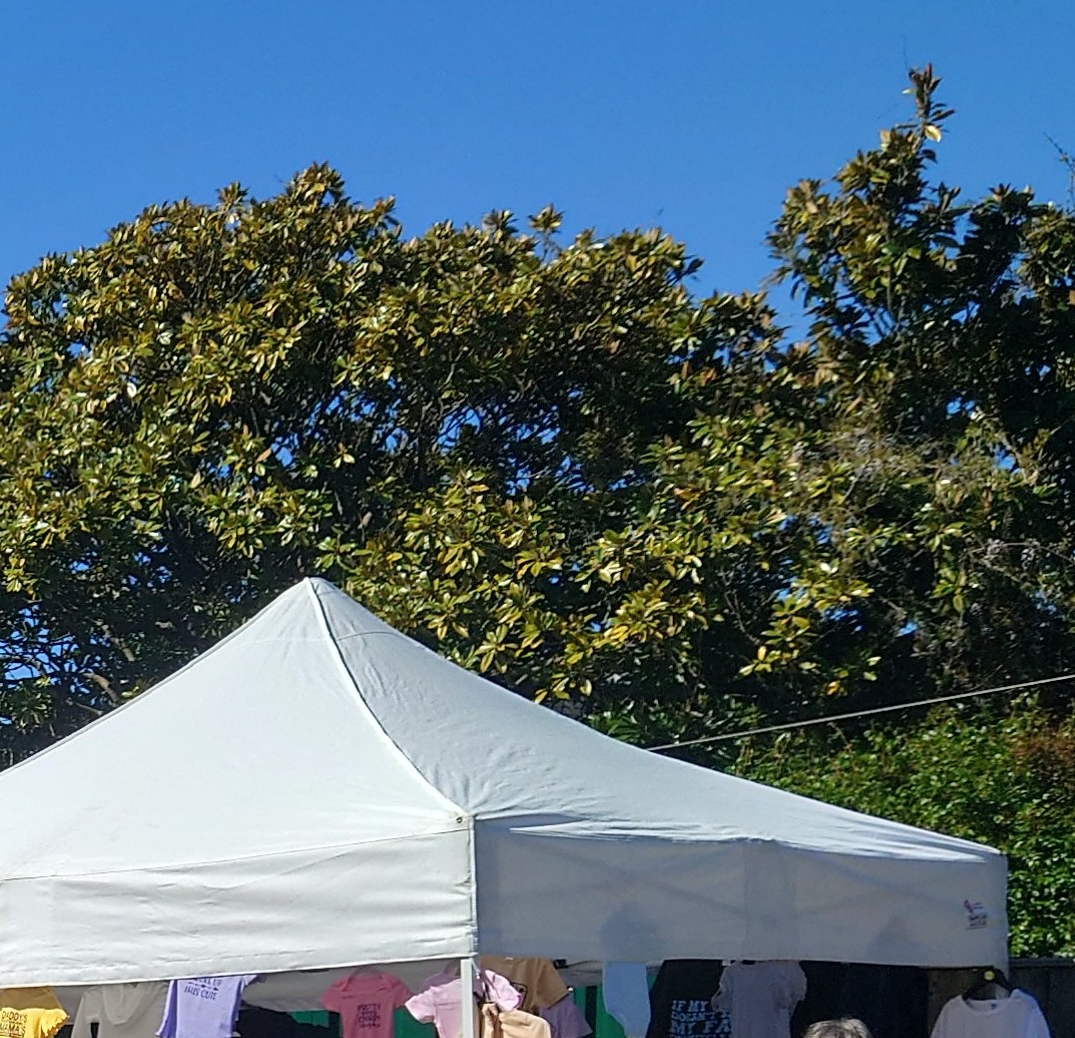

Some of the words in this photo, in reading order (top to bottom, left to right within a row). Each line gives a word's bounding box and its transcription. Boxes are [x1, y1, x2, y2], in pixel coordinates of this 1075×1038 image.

[672, 1000, 687, 1011] IF
[688, 1000, 709, 1012] MY
[670, 1020, 696, 1036] MY
[702, 1020, 732, 1034] FA
